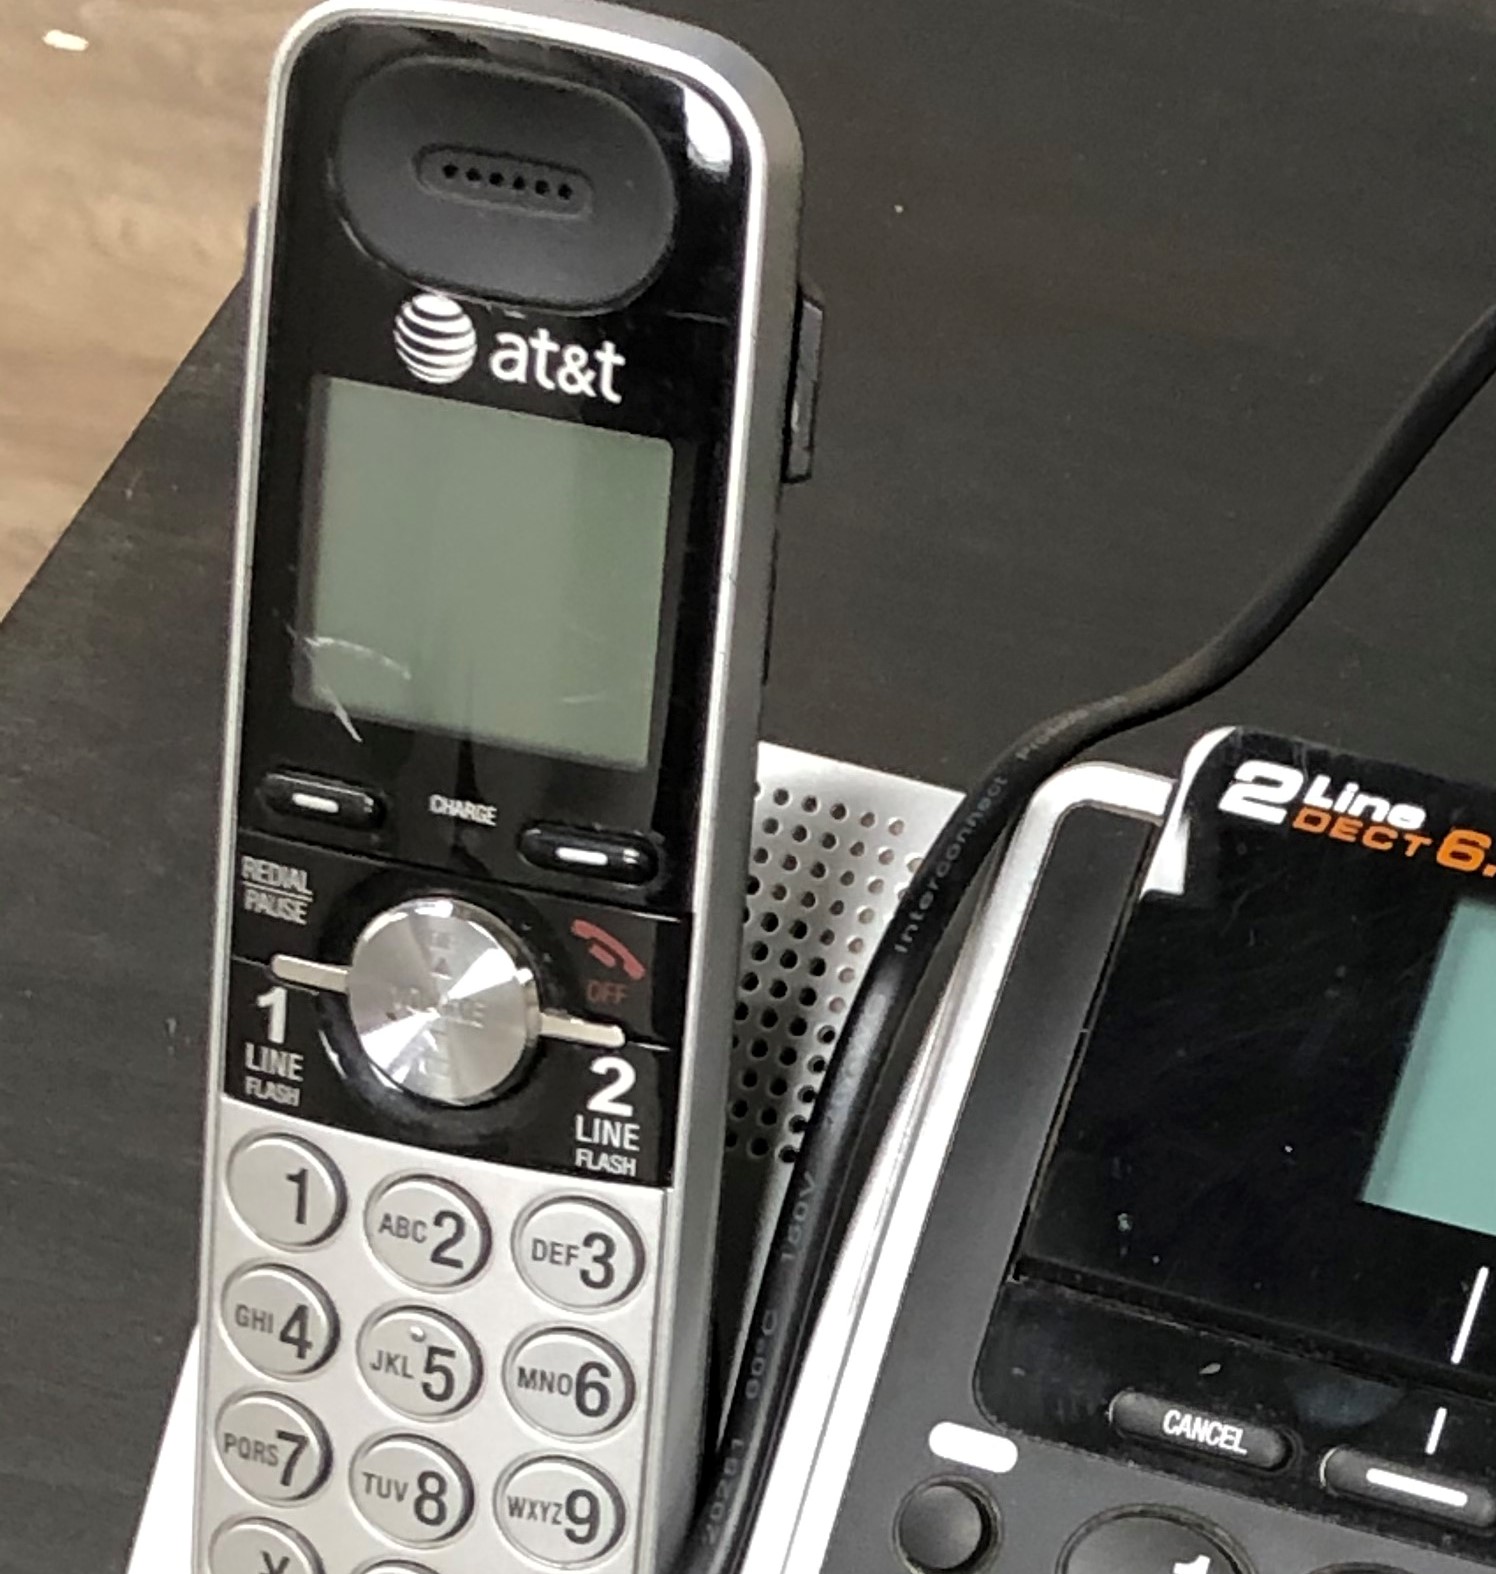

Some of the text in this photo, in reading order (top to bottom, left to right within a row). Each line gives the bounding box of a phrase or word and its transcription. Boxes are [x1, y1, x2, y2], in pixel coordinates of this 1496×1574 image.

[489, 329, 625, 402] at&t
[429, 795, 497, 827] CHARGE
[1218, 760, 1427, 830] 2 Line
[1293, 806, 1431, 857] DECT
[242, 856, 312, 893] REDIAL
[244, 891, 308, 925] PAUSE
[256, 987, 287, 1044] 1
[587, 982, 627, 1005] OFF
[246, 1044, 303, 1083] LINE
[246, 1076, 299, 1106] FLASH
[587, 1056, 636, 1117] 2
[576, 1116, 639, 1151] LINE
[576, 1149, 637, 1176] FLASH
[286, 1169, 308, 1225] 1
[430, 1210, 466, 1268] 2
[579, 1232, 615, 1290] 3
[280, 1304, 312, 1359] 4
[421, 1346, 457, 1402] 5
[574, 1361, 610, 1417] 6
[277, 1429, 308, 1487] 7
[1163, 1409, 1248, 1456] CANCEL
[414, 1470, 447, 1527] 8
[564, 1488, 600, 1545] 9
